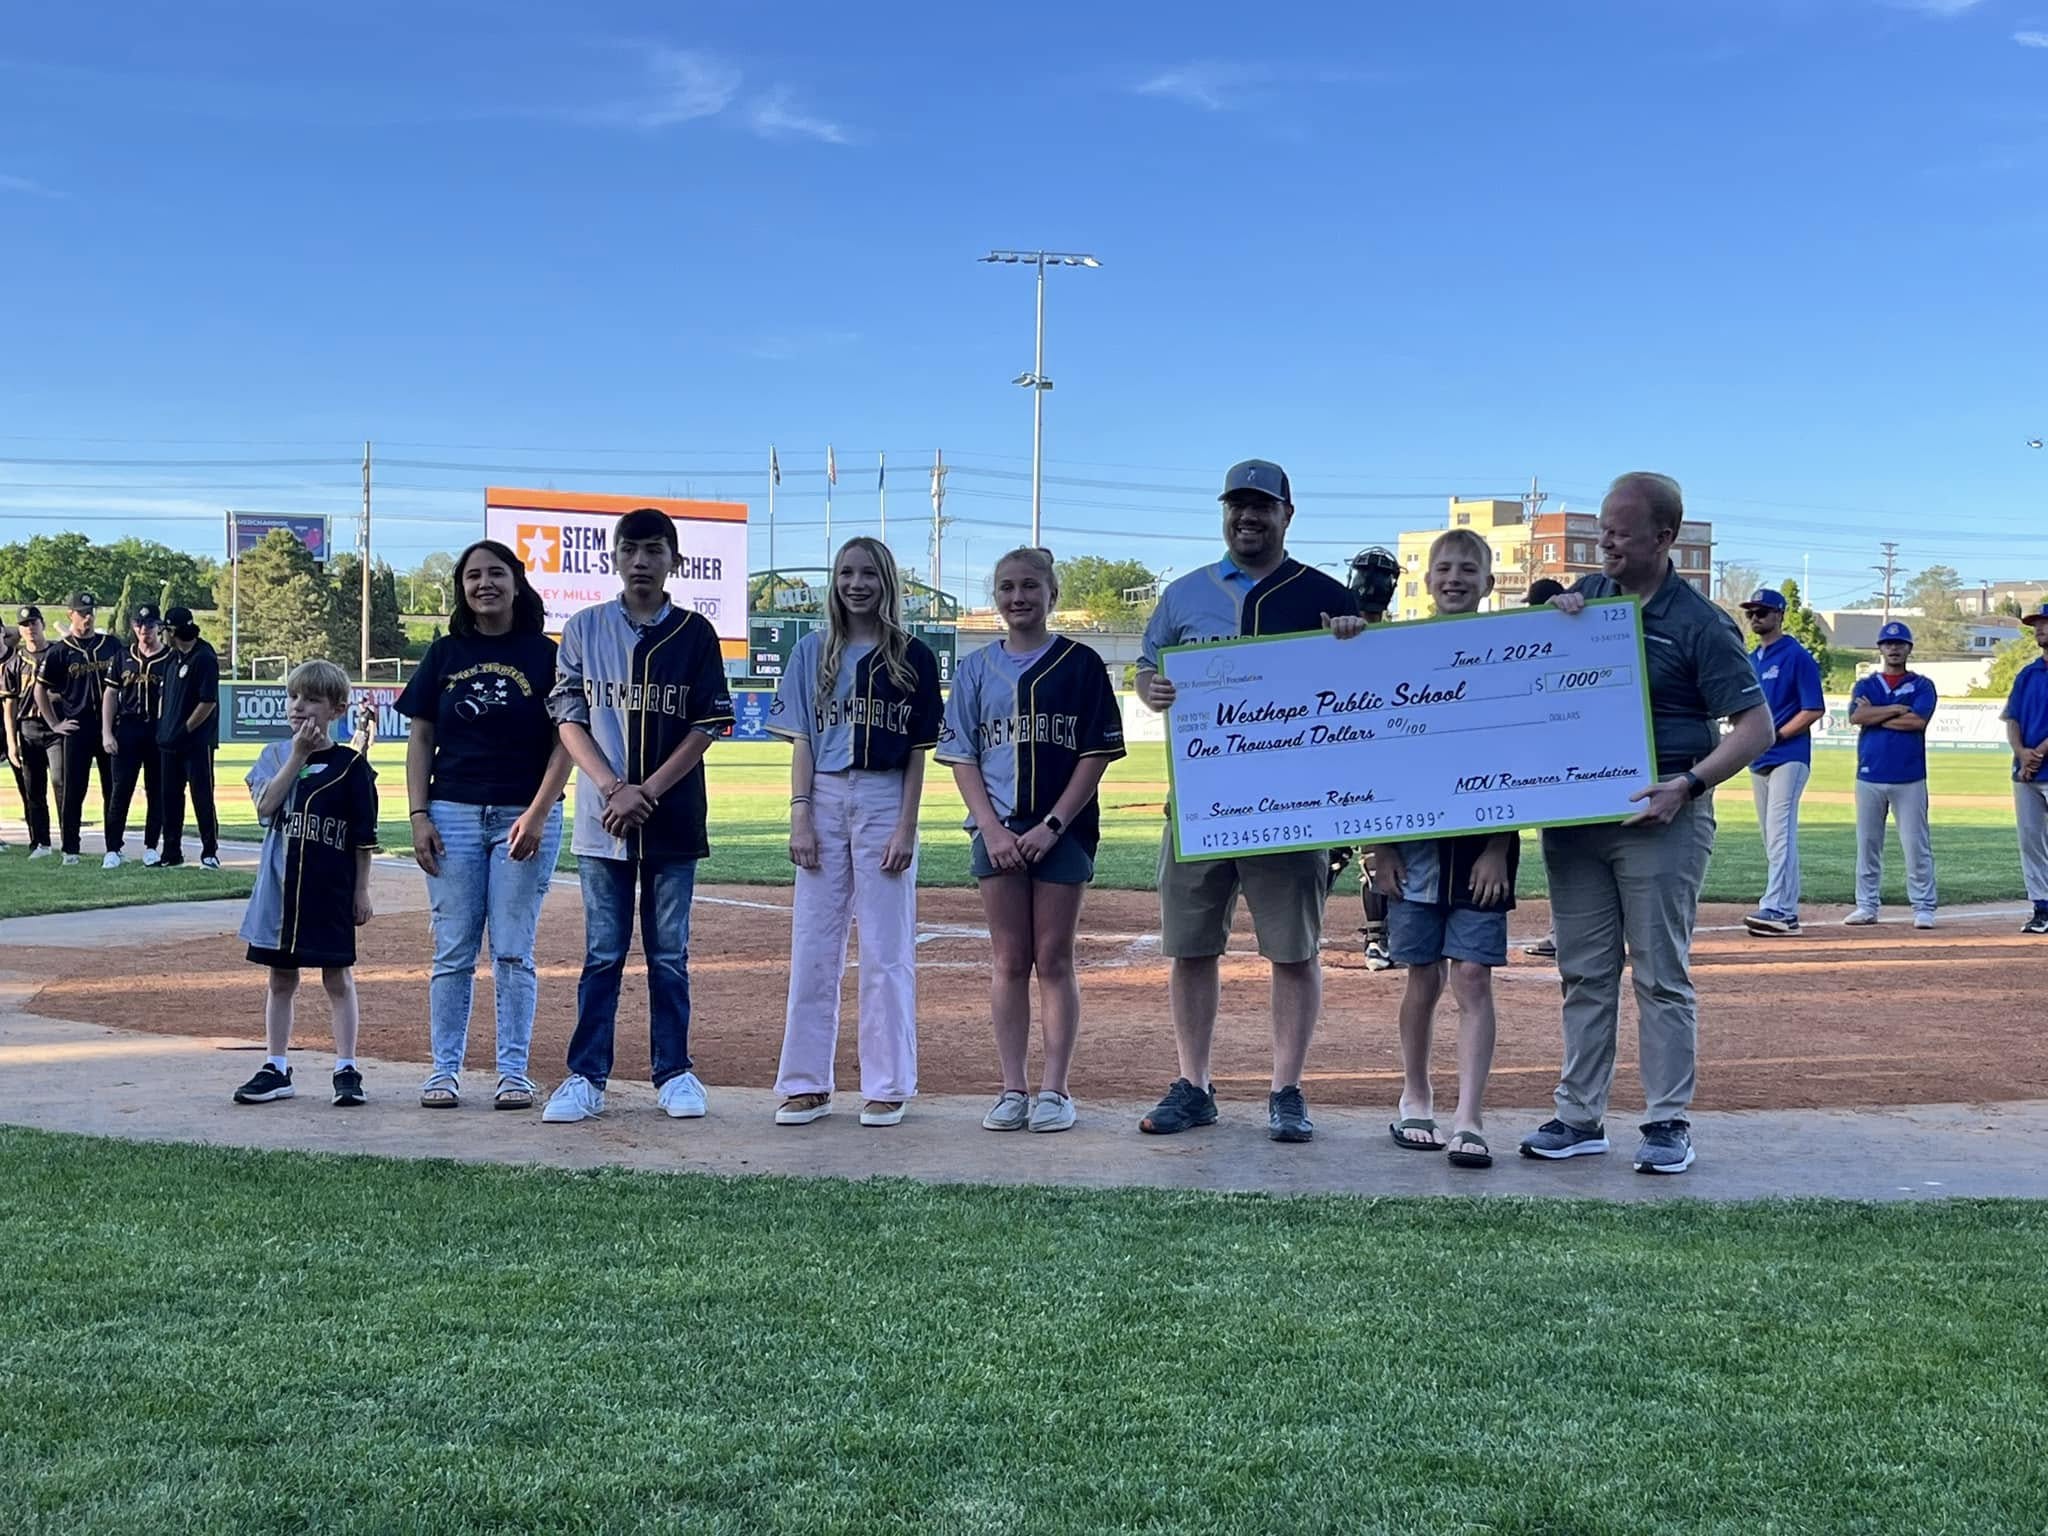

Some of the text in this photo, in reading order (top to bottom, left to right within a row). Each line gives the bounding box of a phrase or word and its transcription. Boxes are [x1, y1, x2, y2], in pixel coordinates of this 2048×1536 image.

[562, 526, 607, 551] STEM
[563, 589, 601, 601] MILLS
[1602, 608, 1627, 622] 123
[770, 628, 779, 642] 3
[1450, 651, 1481, 668] June
[1502, 641, 1553, 661] 2024
[1535, 677, 1544, 692] $
[237, 697, 272, 718] 100
[372, 690, 394, 705] YOU
[584, 679, 690, 719] BISMARCK
[1216, 680, 1467, 726] Westhope Public School
[347, 705, 412, 736] GME
[1549, 711, 1581, 722] DOLLARS
[1186, 738, 1222, 758] One
[1226, 730, 1306, 753] Thousand
[1310, 725, 1375, 744] Dollars
[1498, 773, 1561, 790] Resources
[1566, 765, 1640, 782] Foundation
[1208, 802, 1253, 818] Science
[1258, 797, 1322, 812] Classroom
[1325, 789, 1375, 807] Refresh
[1475, 804, 1515, 823] 0123
